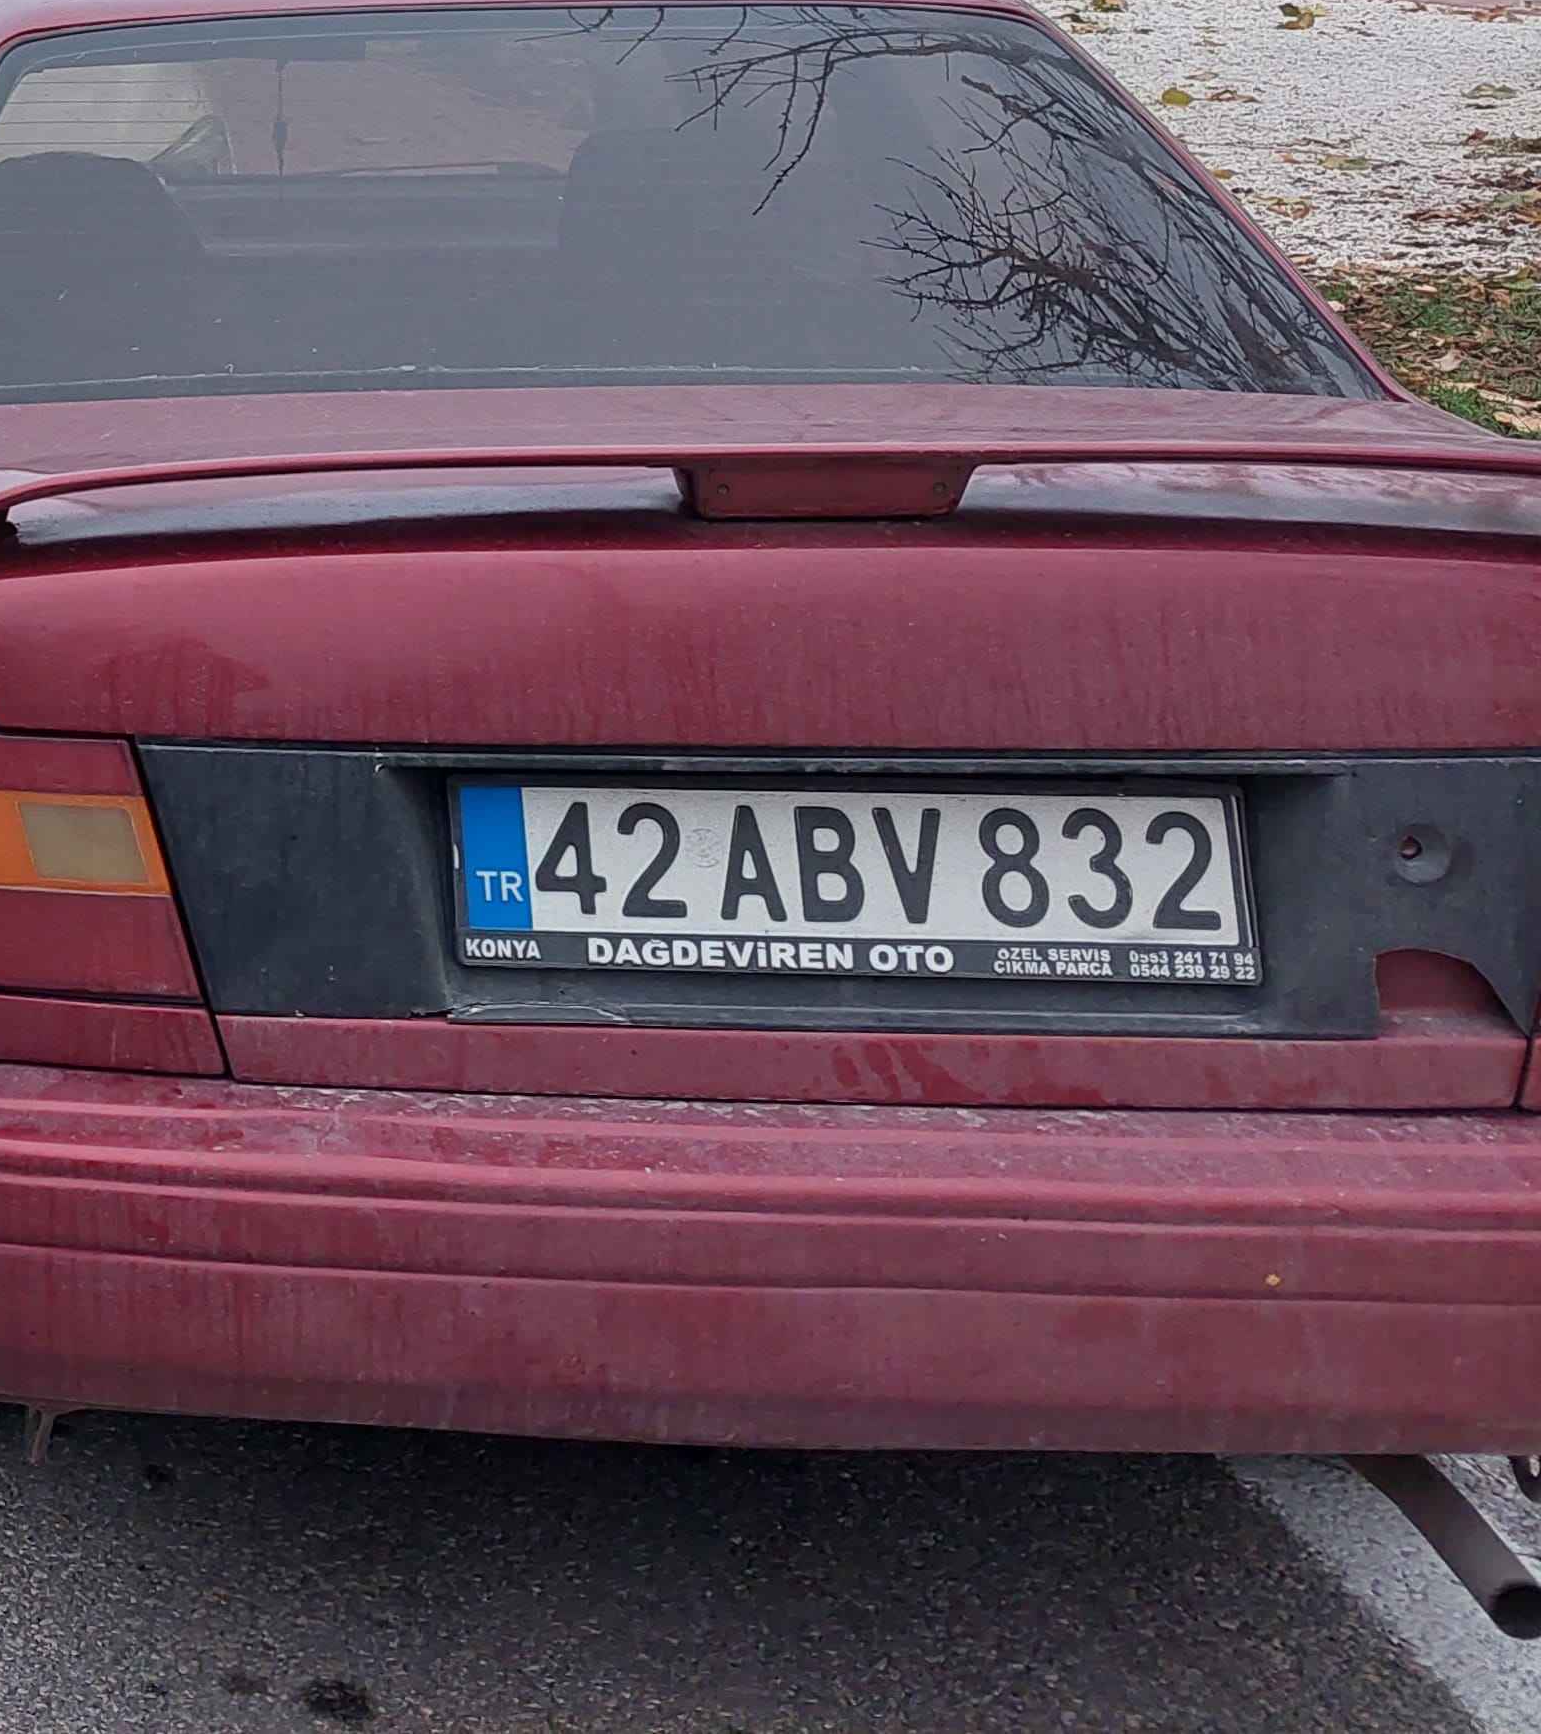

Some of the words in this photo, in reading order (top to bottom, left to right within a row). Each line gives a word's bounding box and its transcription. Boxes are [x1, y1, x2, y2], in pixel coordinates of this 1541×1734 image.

[535, 801, 688, 917] 42
[720, 804, 942, 925] ABV
[979, 807, 1221, 931] 832
[476, 870, 524, 902] TR
[466, 938, 542, 960] KONYA
[869, 943, 954, 973] OTO
[1174, 951, 1202, 964] 241
[1209, 952, 1228, 965] 71
[1130, 963, 1171, 977] 0544
[1235, 967, 1256, 980] 22
